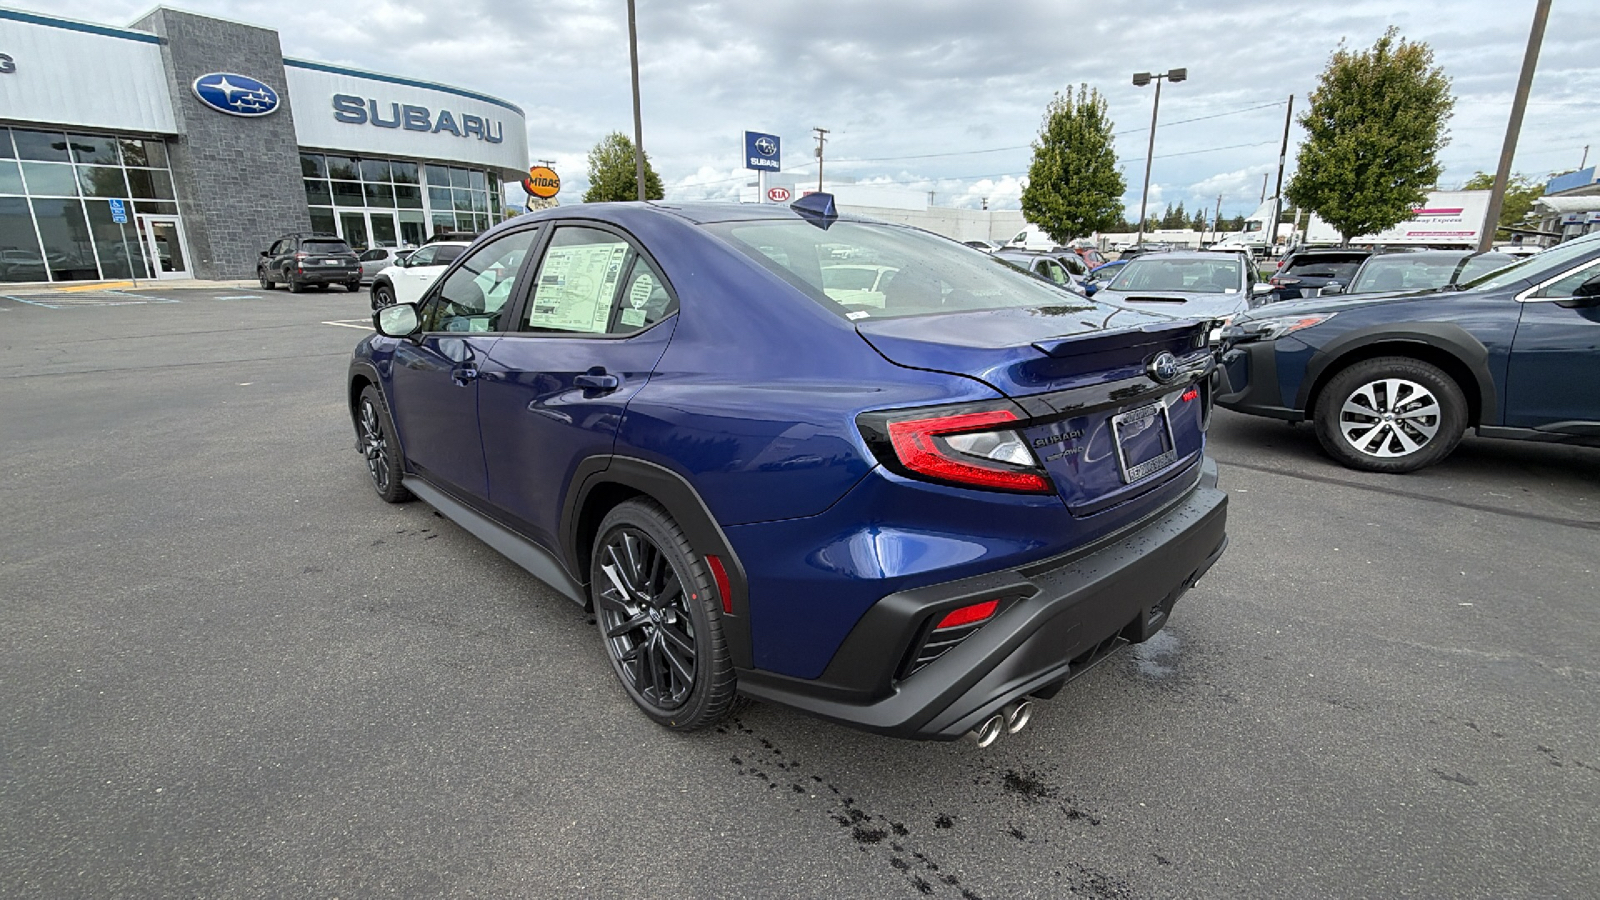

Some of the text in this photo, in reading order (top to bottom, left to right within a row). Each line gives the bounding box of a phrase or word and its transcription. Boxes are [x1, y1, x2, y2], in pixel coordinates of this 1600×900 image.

[333, 93, 503, 144] SUBARU
[750, 157, 779, 168] SUBARU
[530, 177, 560, 189] MIDAS
[1033, 429, 1086, 447] SUBARU
